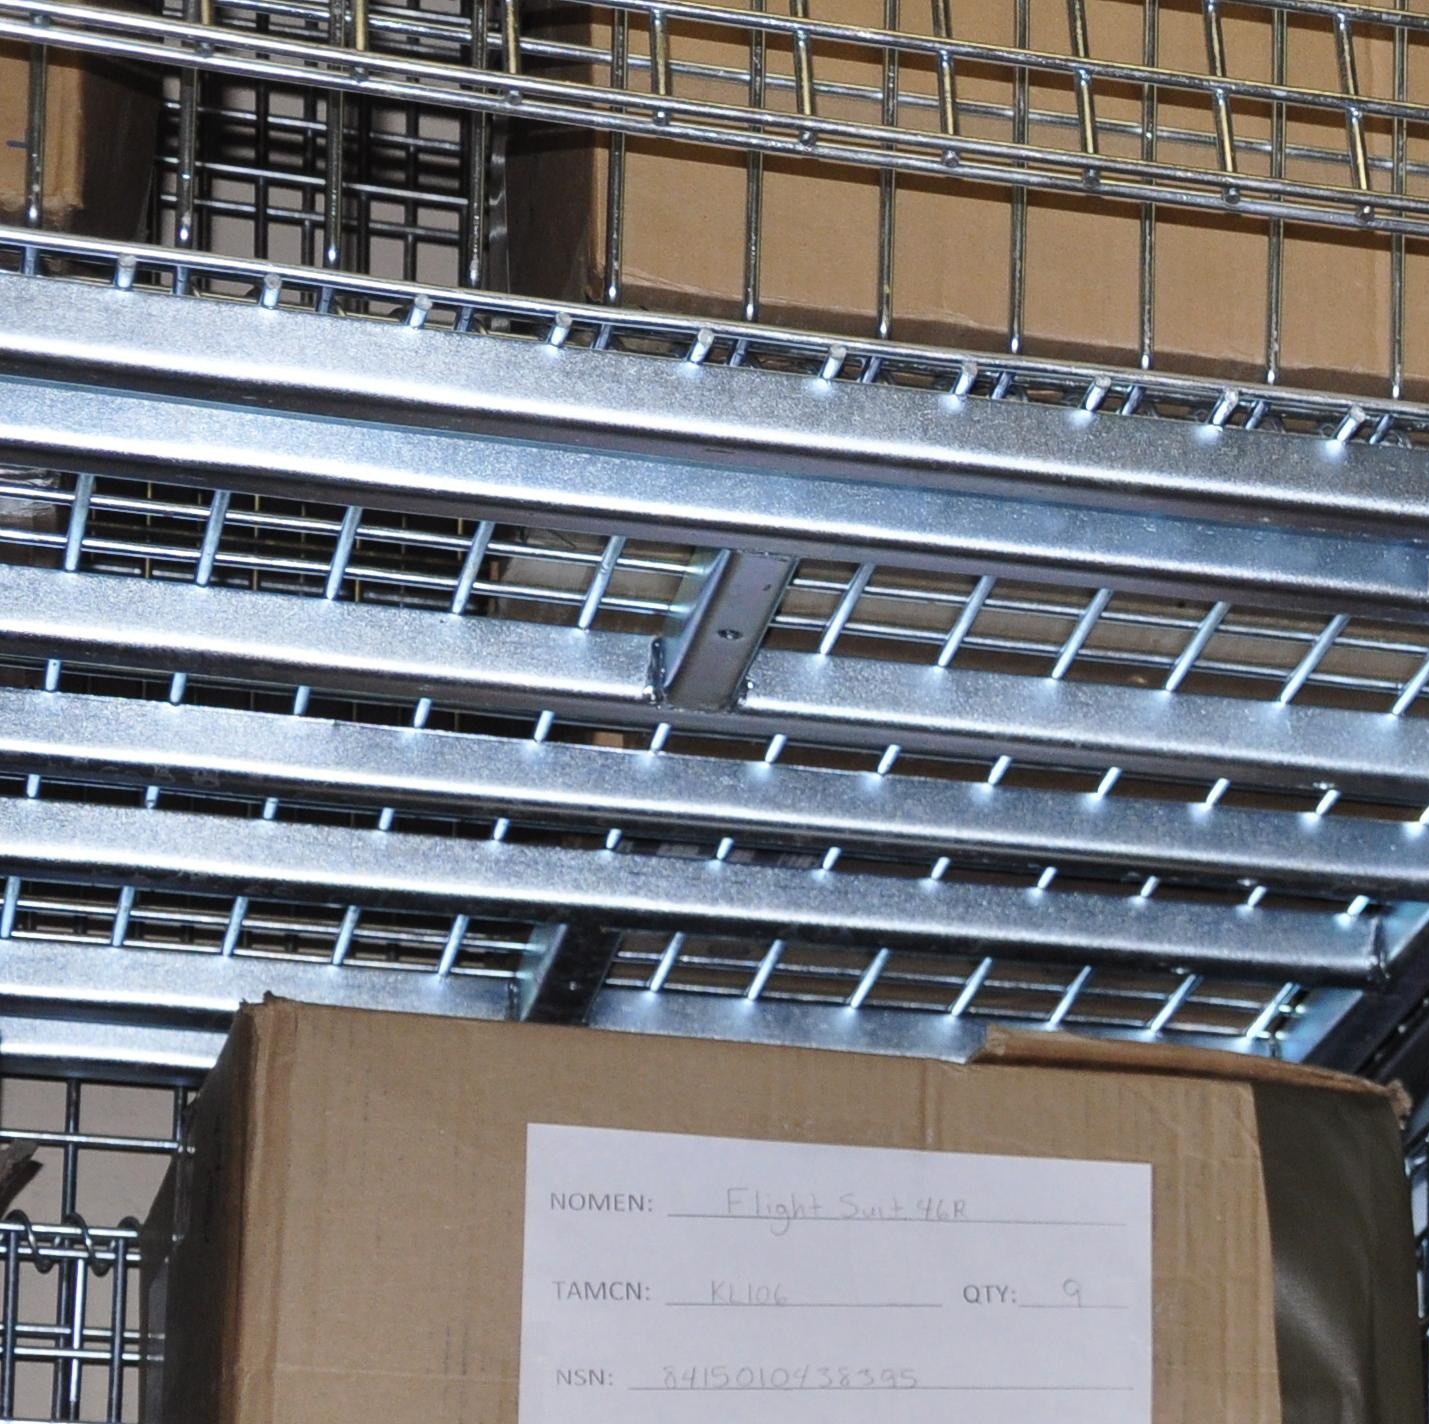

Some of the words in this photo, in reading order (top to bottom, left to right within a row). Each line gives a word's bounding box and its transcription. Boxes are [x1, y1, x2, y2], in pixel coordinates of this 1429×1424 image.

[550, 1192, 654, 1213] NOMEN:
[726, 1187, 823, 1237] Flight
[552, 1280, 651, 1302] TAMCN:
[962, 1284, 1018, 1306] QTY:
[1061, 1277, 1083, 1308] 9
[555, 1368, 614, 1387] NSN:
